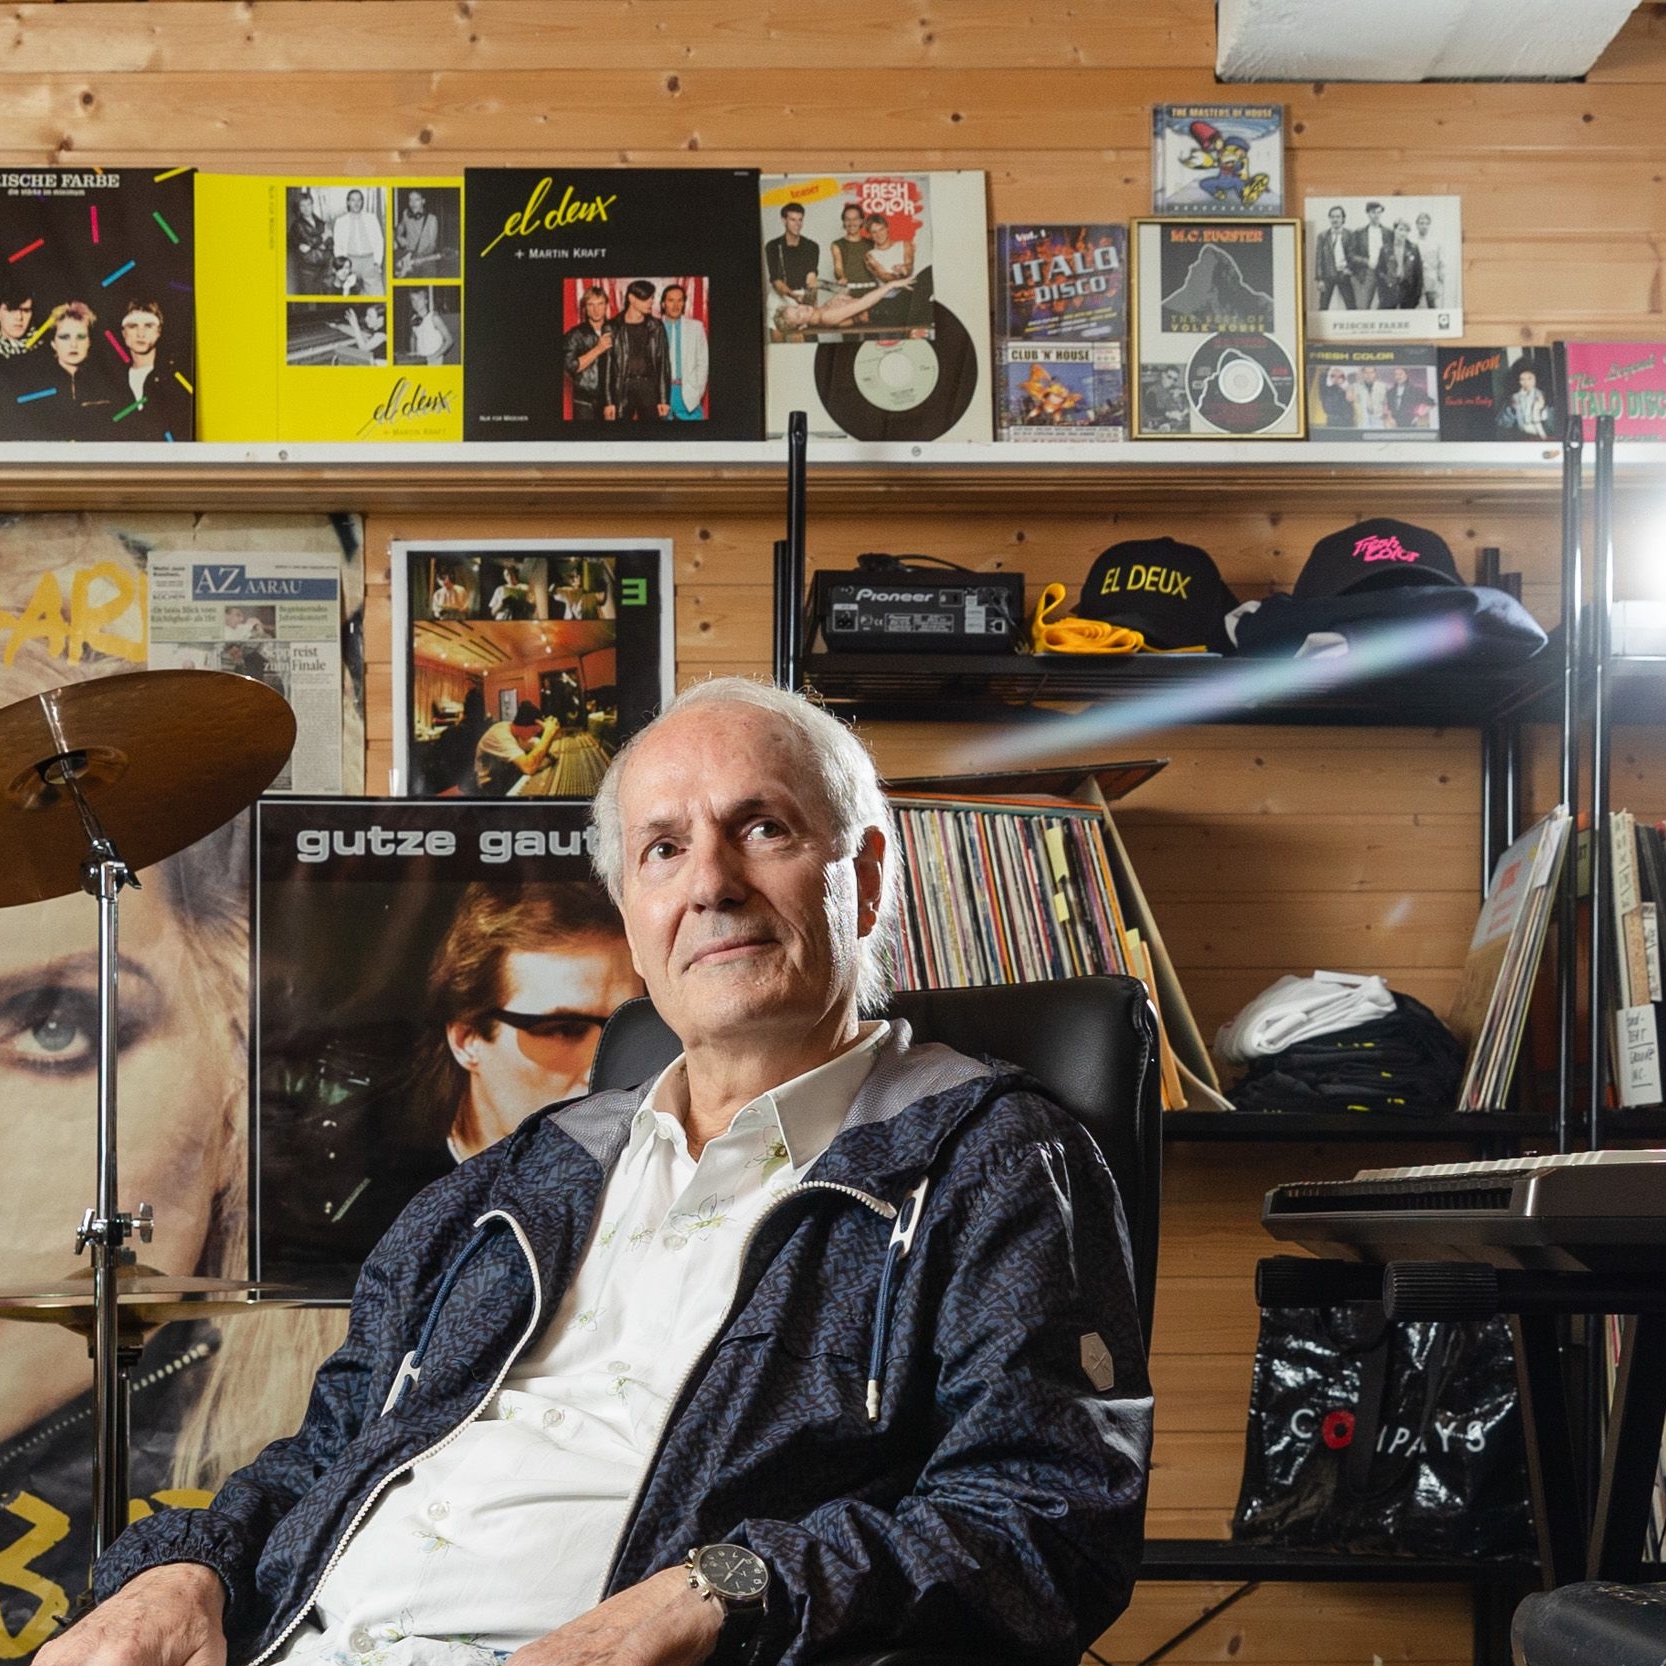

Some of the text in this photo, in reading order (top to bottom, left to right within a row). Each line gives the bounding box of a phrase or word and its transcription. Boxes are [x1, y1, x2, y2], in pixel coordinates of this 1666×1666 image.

[1172, 108, 1272, 118] THE MASTERS OF HOUSE
[61, 173, 120, 188] FARBE
[790, 184, 820, 198] teaser
[862, 183, 908, 200] FRESH
[862, 199, 915, 216] COLOR
[481, 177, 617, 257] el deux
[529, 247, 569, 259] MARTIN
[573, 247, 606, 259] KRAFT
[1010, 246, 1118, 286] ITALO
[1035, 276, 1107, 304] DISCO
[1011, 350, 1039, 360] CLUB
[1056, 350, 1090, 360] HOUSE
[1352, 352, 1394, 361] COLOR
[1442, 354, 1502, 391] Sharon
[1572, 389, 1623, 419] ITALO
[1353, 534, 1399, 556] Fresh
[1364, 545, 1420, 562] Color
[195, 567, 241, 593] AZ
[245, 580, 303, 593] AARAU
[1100, 564, 1192, 599] EL DEUX
[856, 588, 933, 602] Pioneer
[293, 646, 318, 656] reist
[293, 660, 326, 671] Finale
[297, 825, 456, 862] gutze
